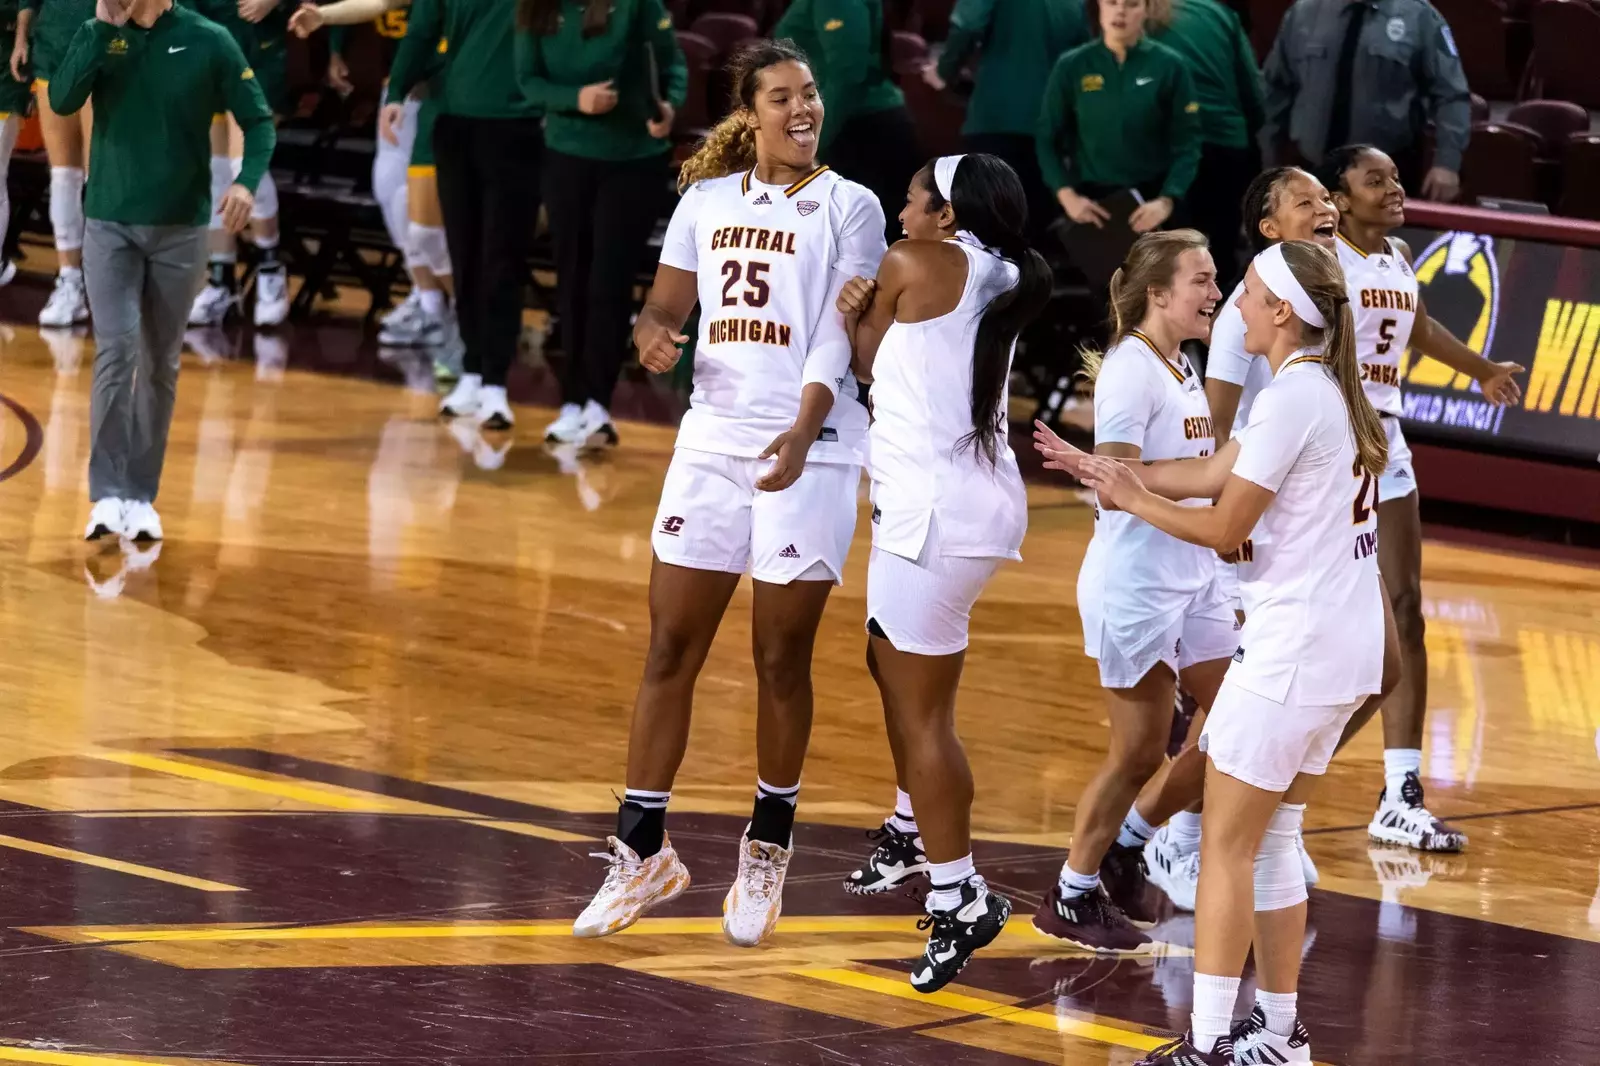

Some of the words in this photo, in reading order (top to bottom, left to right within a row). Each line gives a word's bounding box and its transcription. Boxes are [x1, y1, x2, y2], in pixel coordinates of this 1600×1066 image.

[711, 226, 796, 255] CENTRAL
[721, 260, 770, 309] 25
[709, 318, 791, 348] MICHIGAN
[1376, 318, 1397, 355] 5
[1352, 456, 1379, 525] 2
